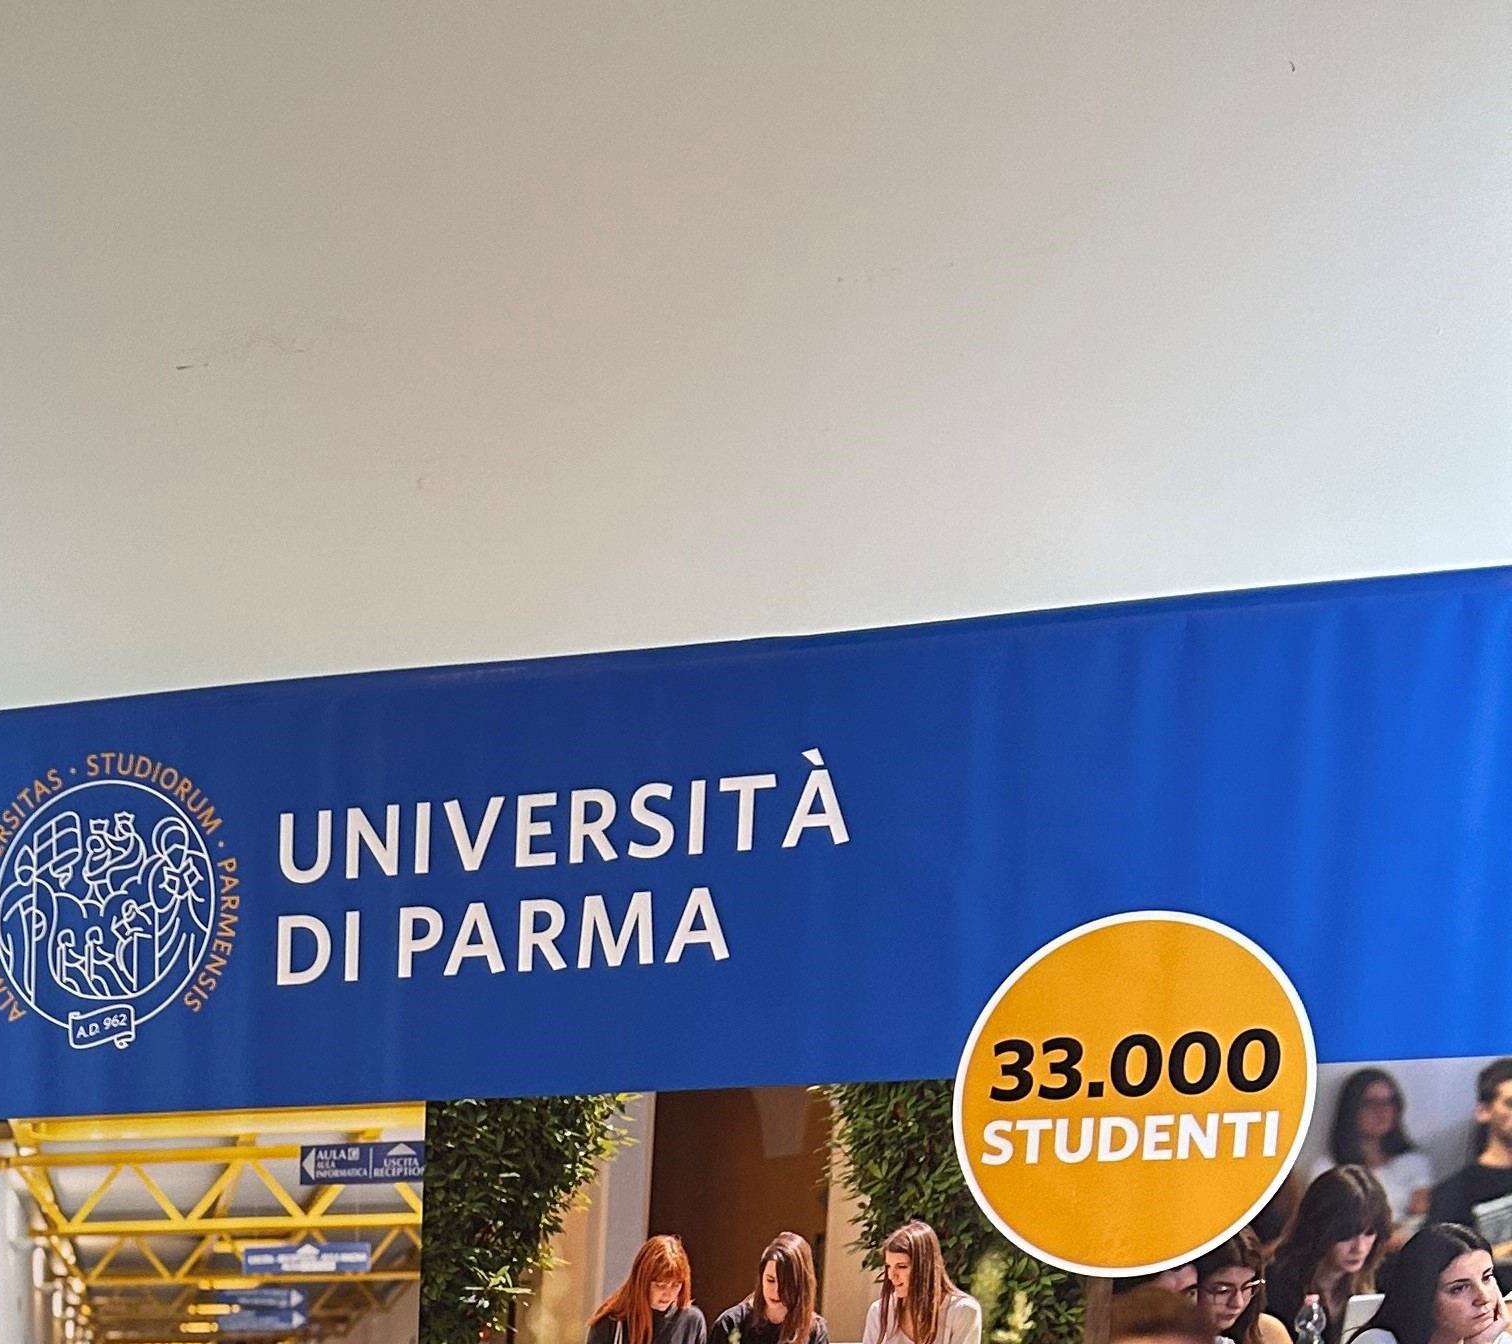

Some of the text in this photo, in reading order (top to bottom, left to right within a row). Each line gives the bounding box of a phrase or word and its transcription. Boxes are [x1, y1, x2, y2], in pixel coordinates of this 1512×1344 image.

[278, 747, 850, 884] UNIVERSITÀ
[86, 752, 223, 835] STUDIORUM
[183, 857, 241, 1013] PARMENSIS
[276, 886, 730, 986] DI PARMA
[76, 1013, 128, 1039] A.D. 962
[989, 1027, 1281, 1102] 33.000
[980, 1110, 1280, 1167] STUDENTI
